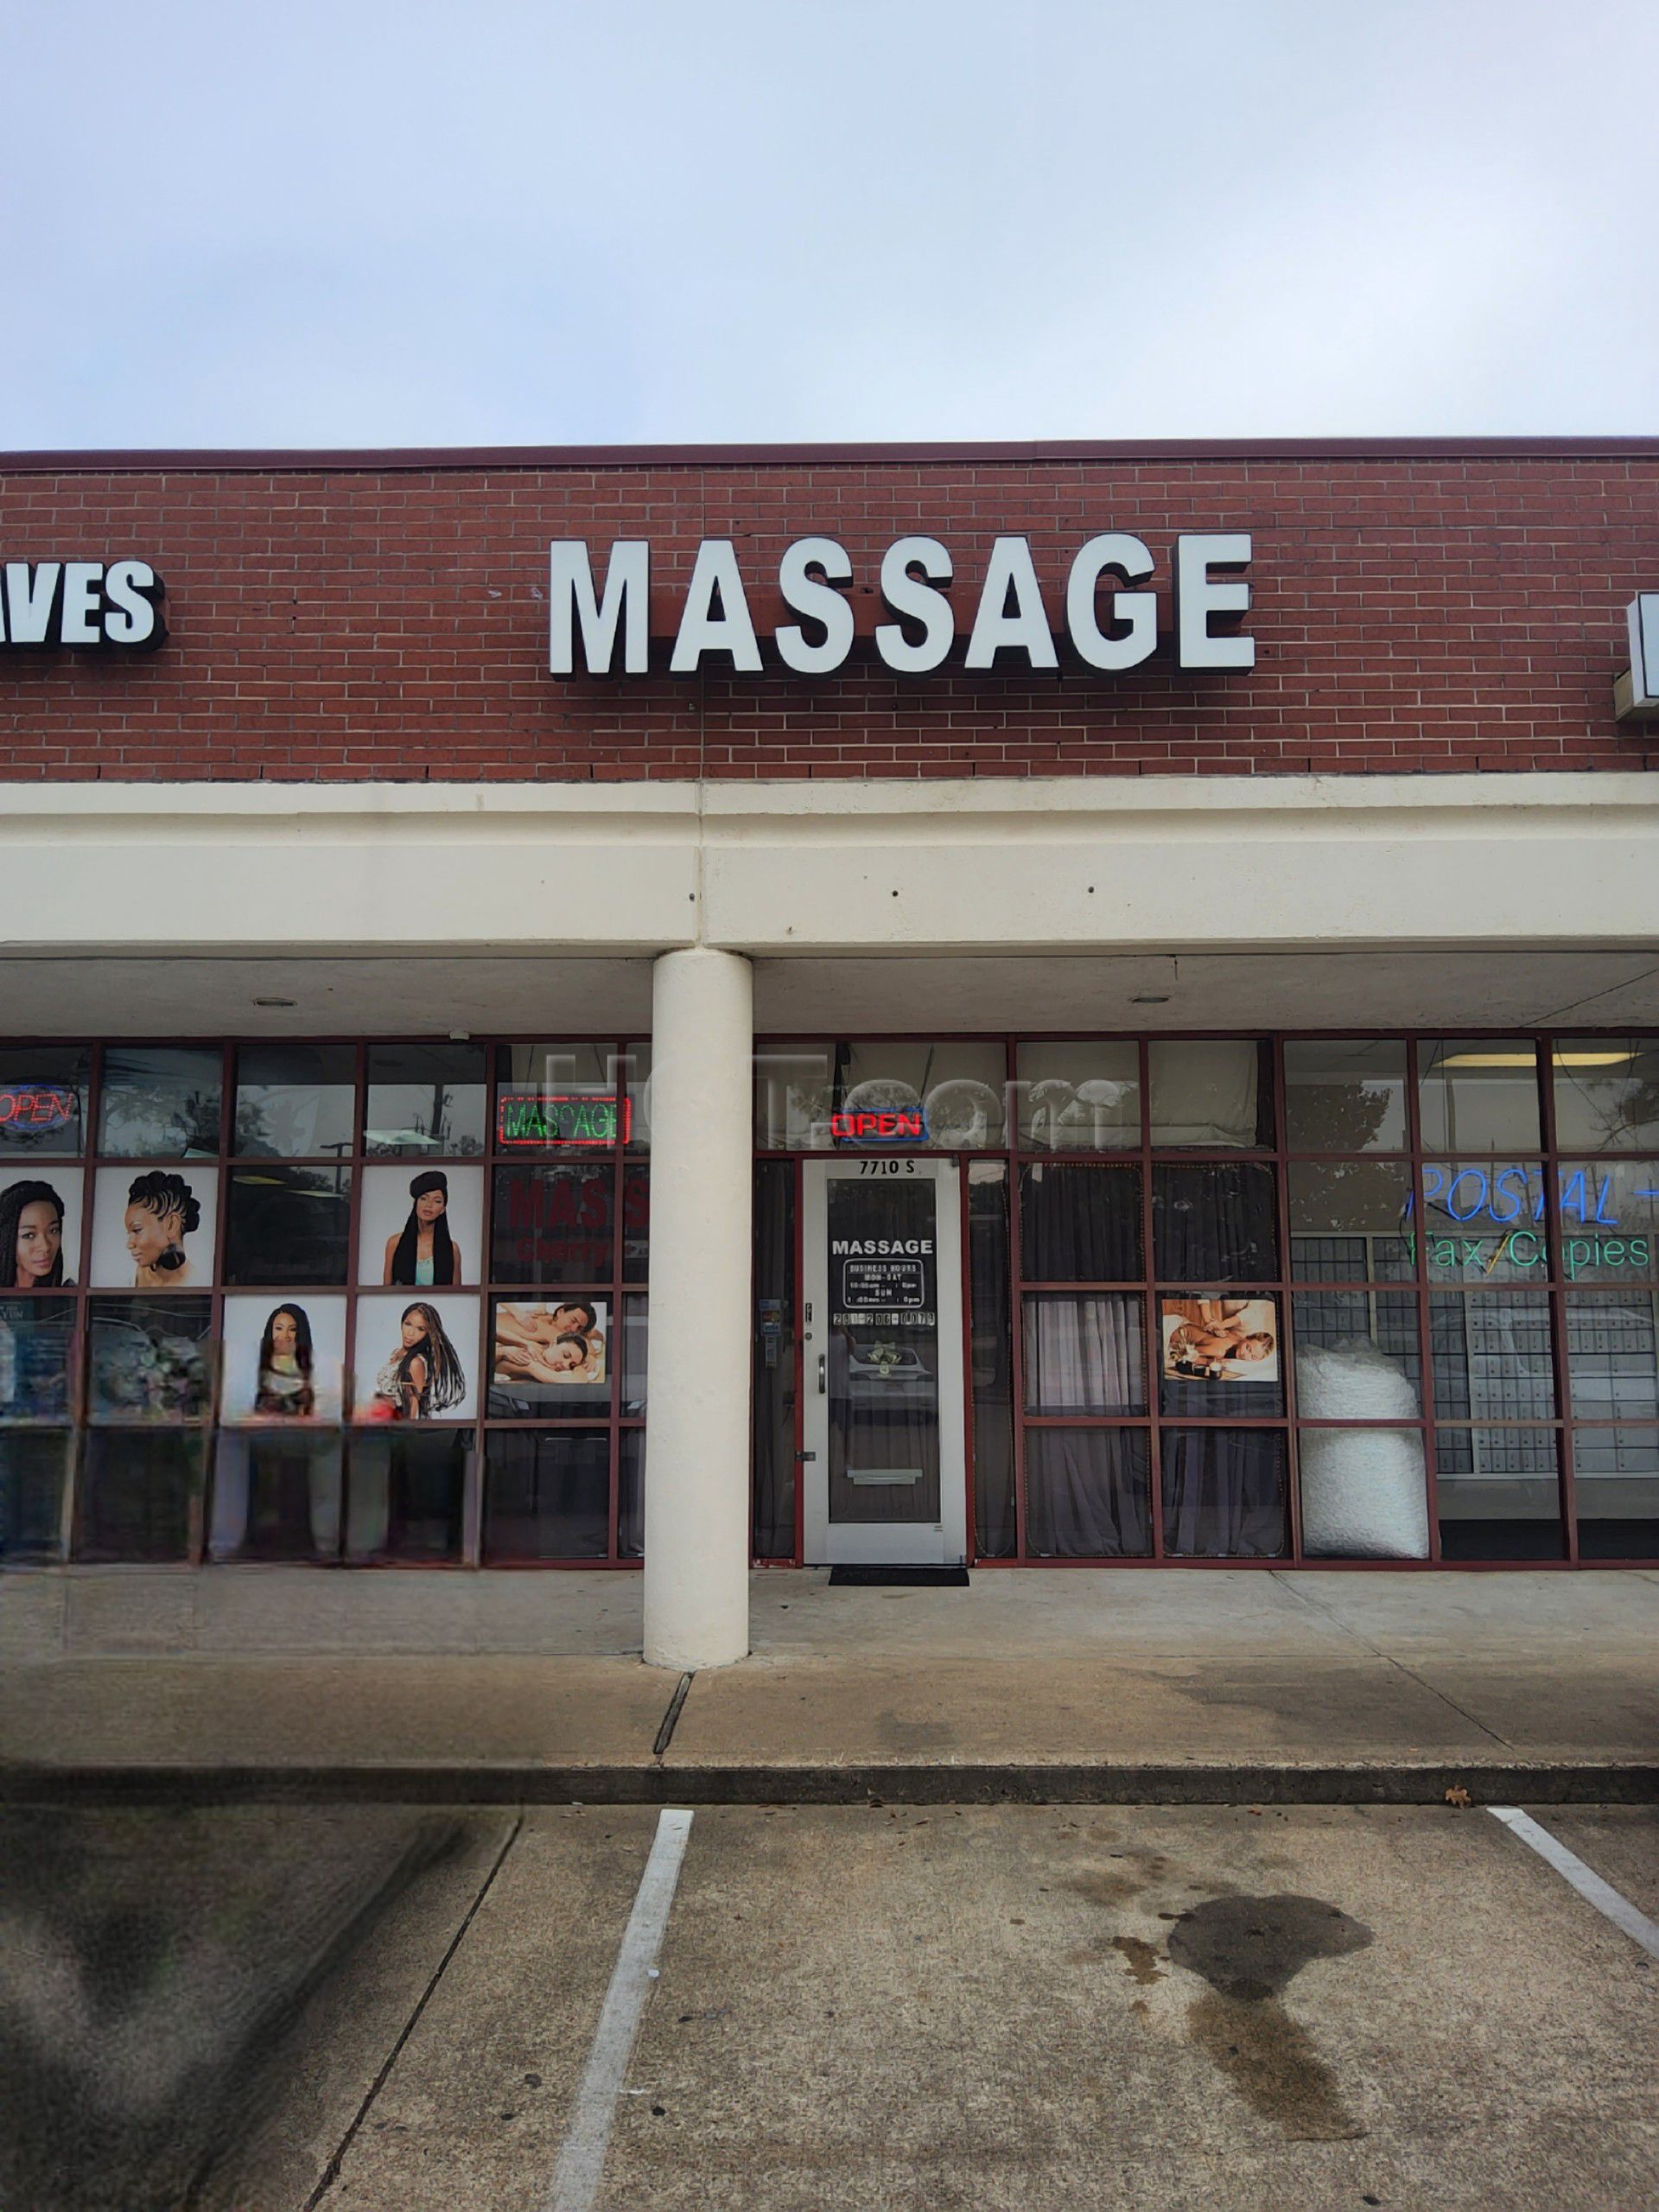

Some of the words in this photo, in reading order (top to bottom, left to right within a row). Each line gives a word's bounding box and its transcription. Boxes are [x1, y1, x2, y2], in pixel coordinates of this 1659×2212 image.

[0, 561, 154, 643] VES
[549, 533, 1255, 675] MASSAGE
[831, 1113, 921, 1136] OPEN
[860, 1160, 899, 1174] 7710
[906, 1160, 915, 1173] S
[832, 1240, 933, 1255] MASSAGE
